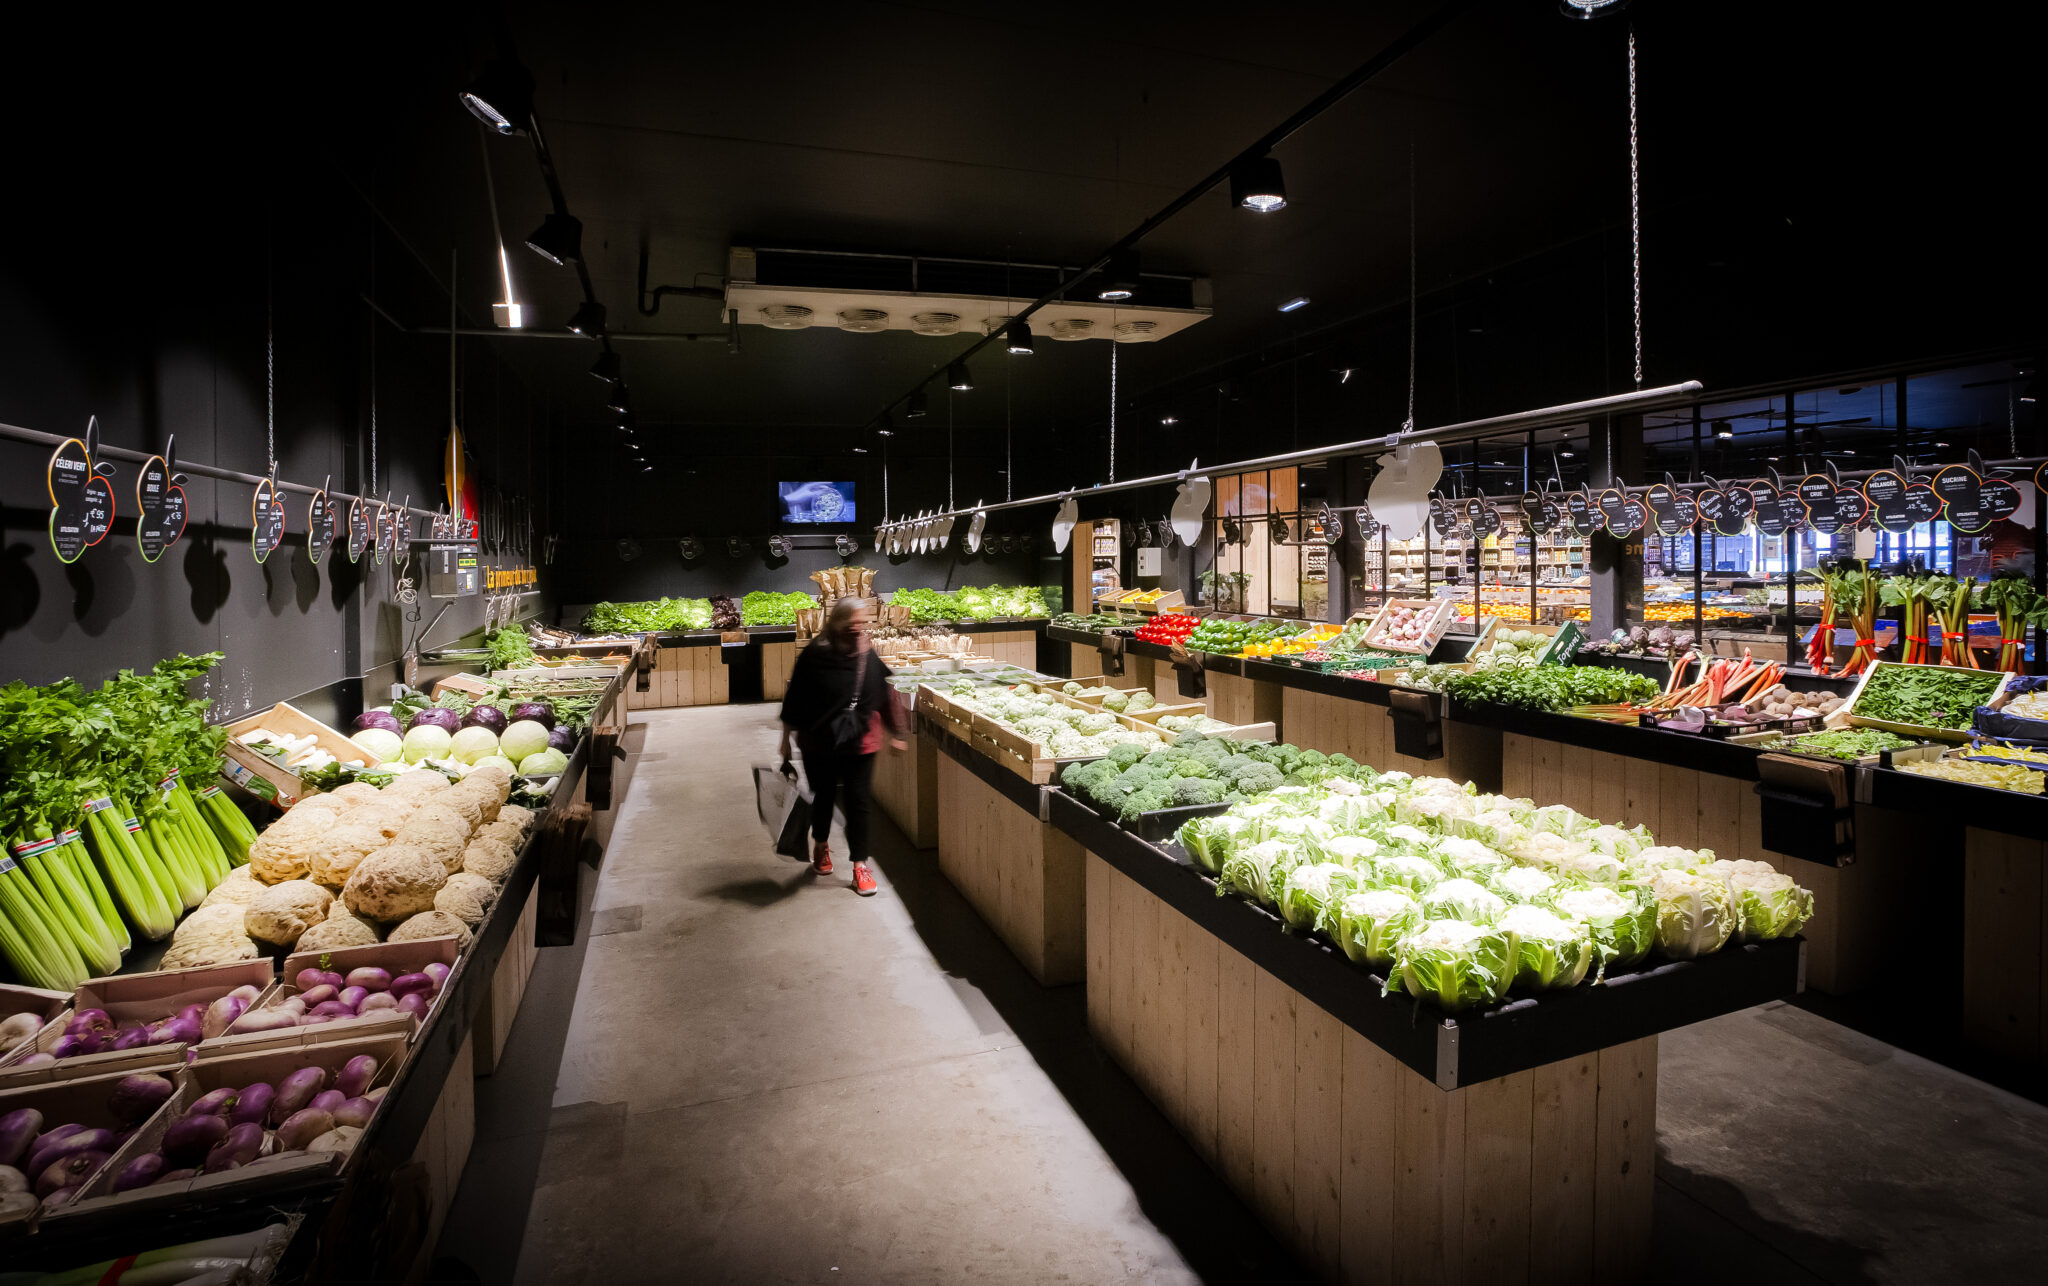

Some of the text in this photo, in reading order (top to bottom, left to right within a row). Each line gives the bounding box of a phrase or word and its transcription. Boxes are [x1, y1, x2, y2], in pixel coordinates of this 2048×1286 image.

[56, 457, 86, 472] CÉLERI VERT
[1942, 476, 1967, 484] SUCRINE
